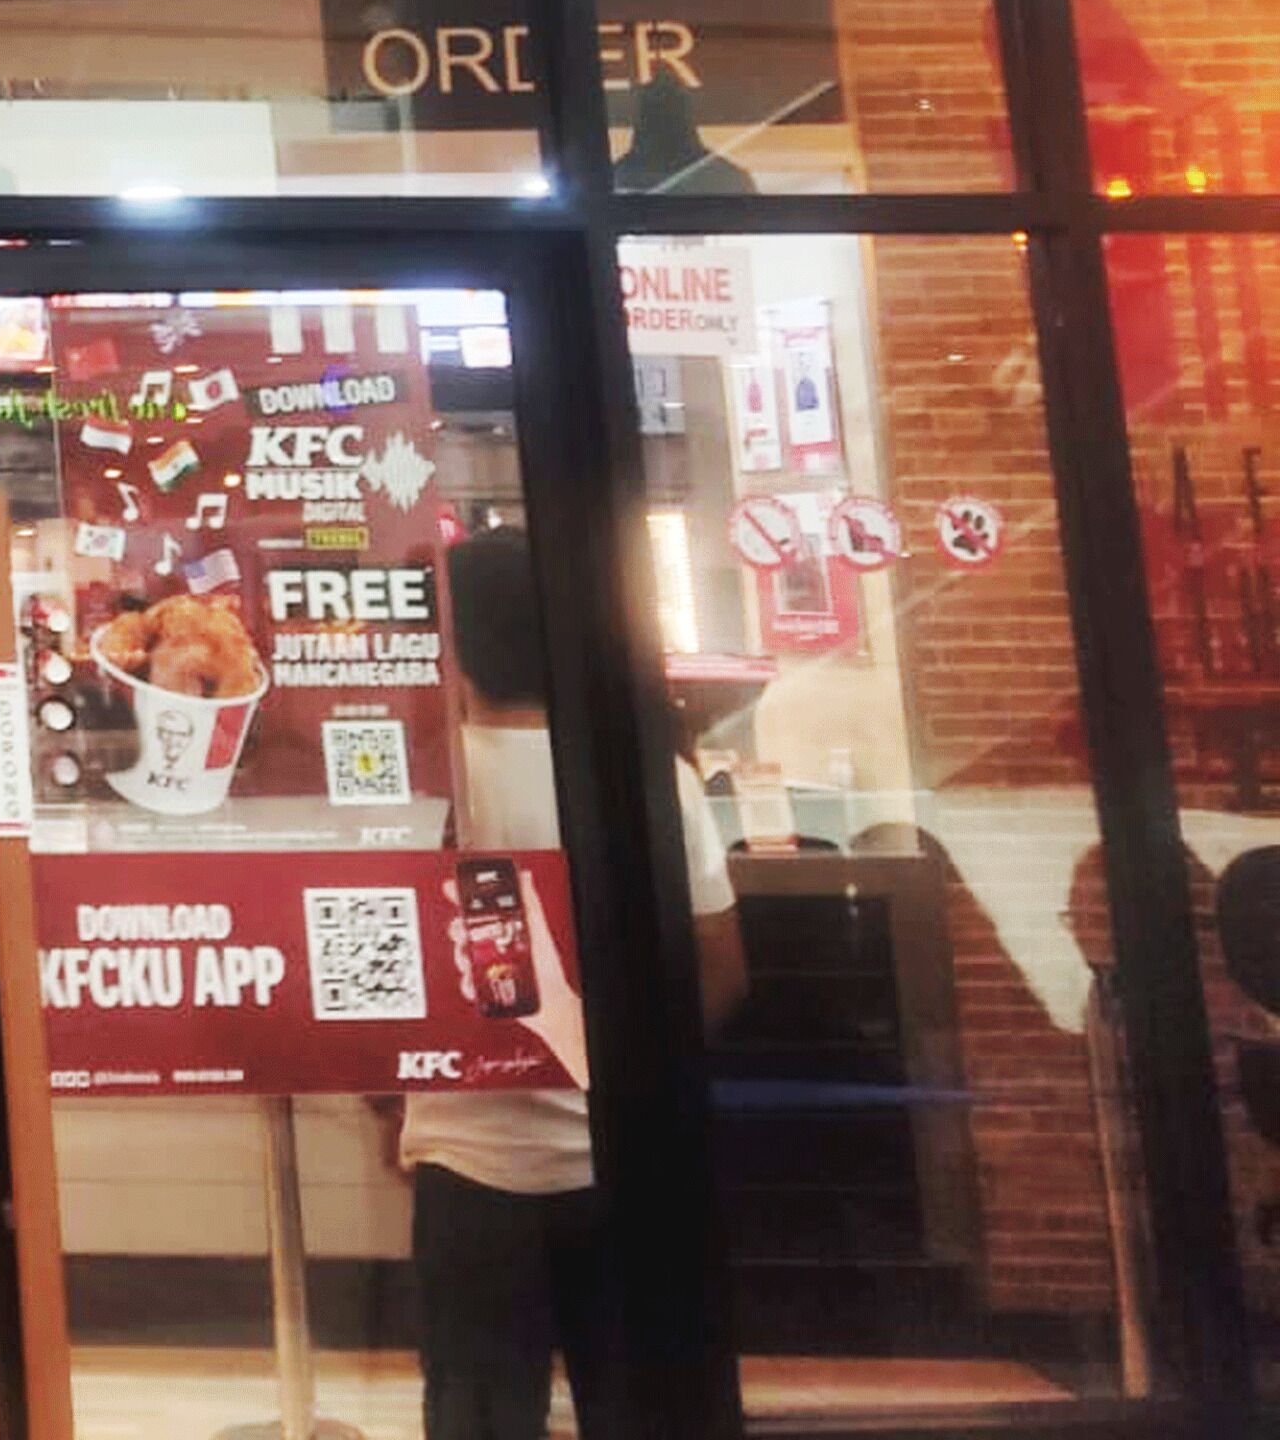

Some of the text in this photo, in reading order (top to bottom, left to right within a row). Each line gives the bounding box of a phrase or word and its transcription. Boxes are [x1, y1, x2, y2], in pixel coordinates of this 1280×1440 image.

[617, 263, 734, 302] ONLINE
[258, 374, 396, 415] DOWNLOAD
[245, 426, 365, 467] KFC
[245, 469, 364, 501] MUSIK
[268, 570, 432, 622] FREE
[272, 632, 441, 660] JUTAAN LAGU
[273, 661, 441, 688] MANCANEGARA
[146, 773, 190, 793] KFC
[76, 903, 231, 942] DOWNLOAD
[39, 946, 286, 1009] KFCKU APP
[396, 1050, 463, 1079] KFC
